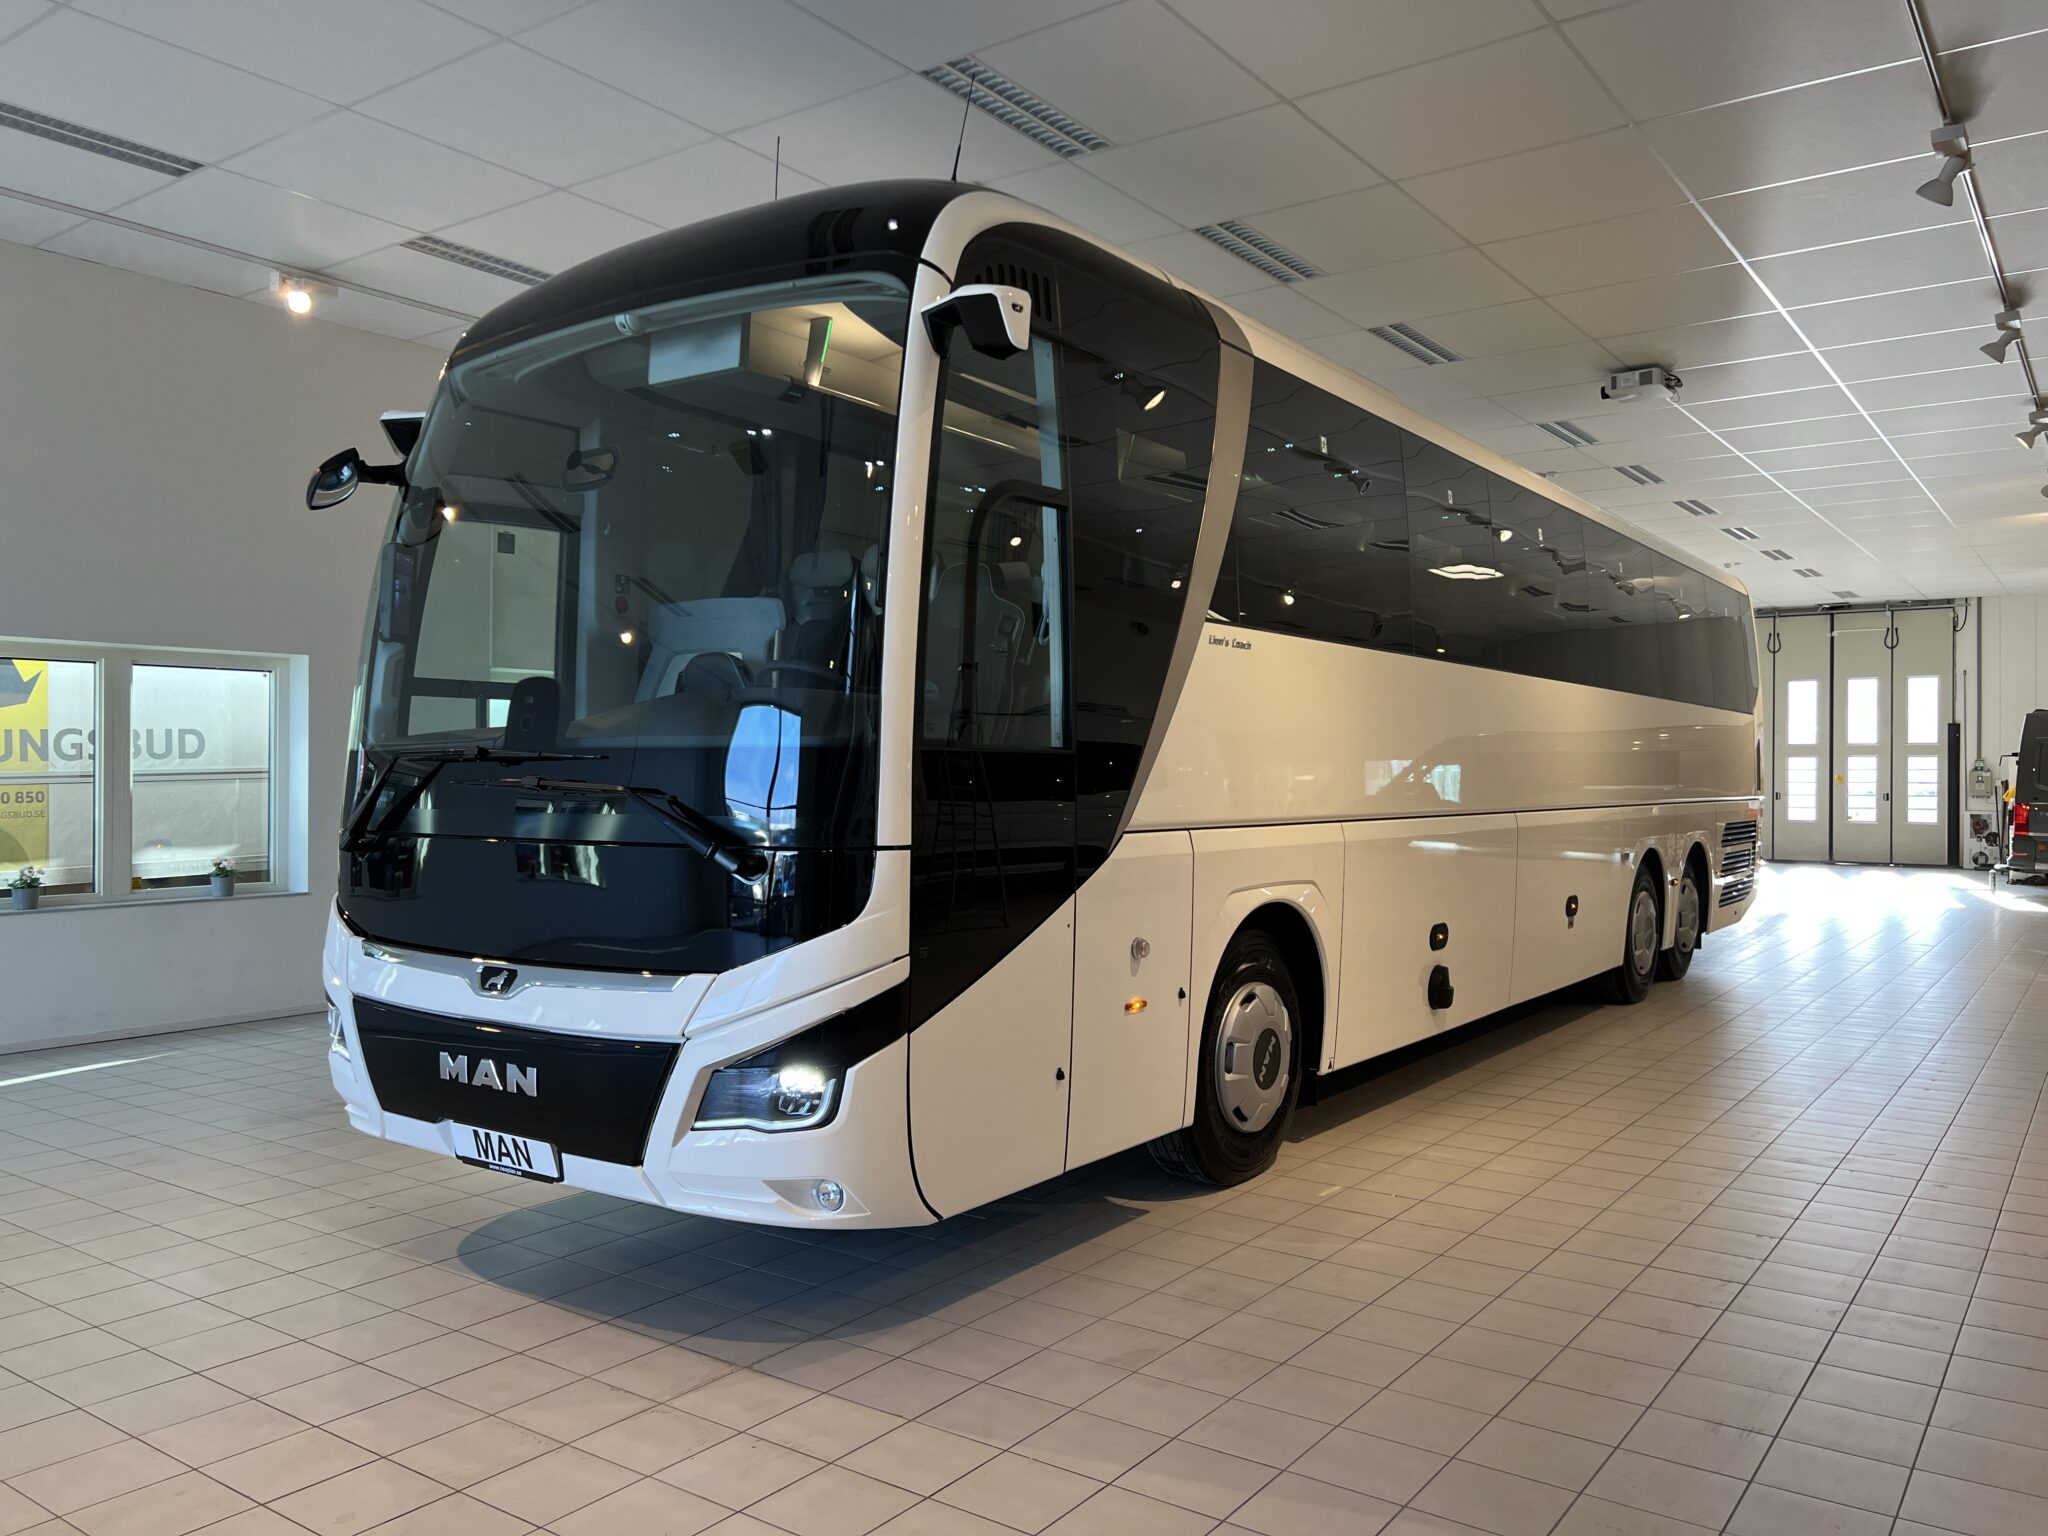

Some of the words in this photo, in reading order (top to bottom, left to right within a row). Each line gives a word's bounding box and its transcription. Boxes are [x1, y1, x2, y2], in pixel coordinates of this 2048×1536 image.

[15, 791, 45, 804] 850
[439, 1051, 538, 1097] MAN
[1258, 1035, 1276, 1083] MAN
[472, 1129, 534, 1169] MAN
